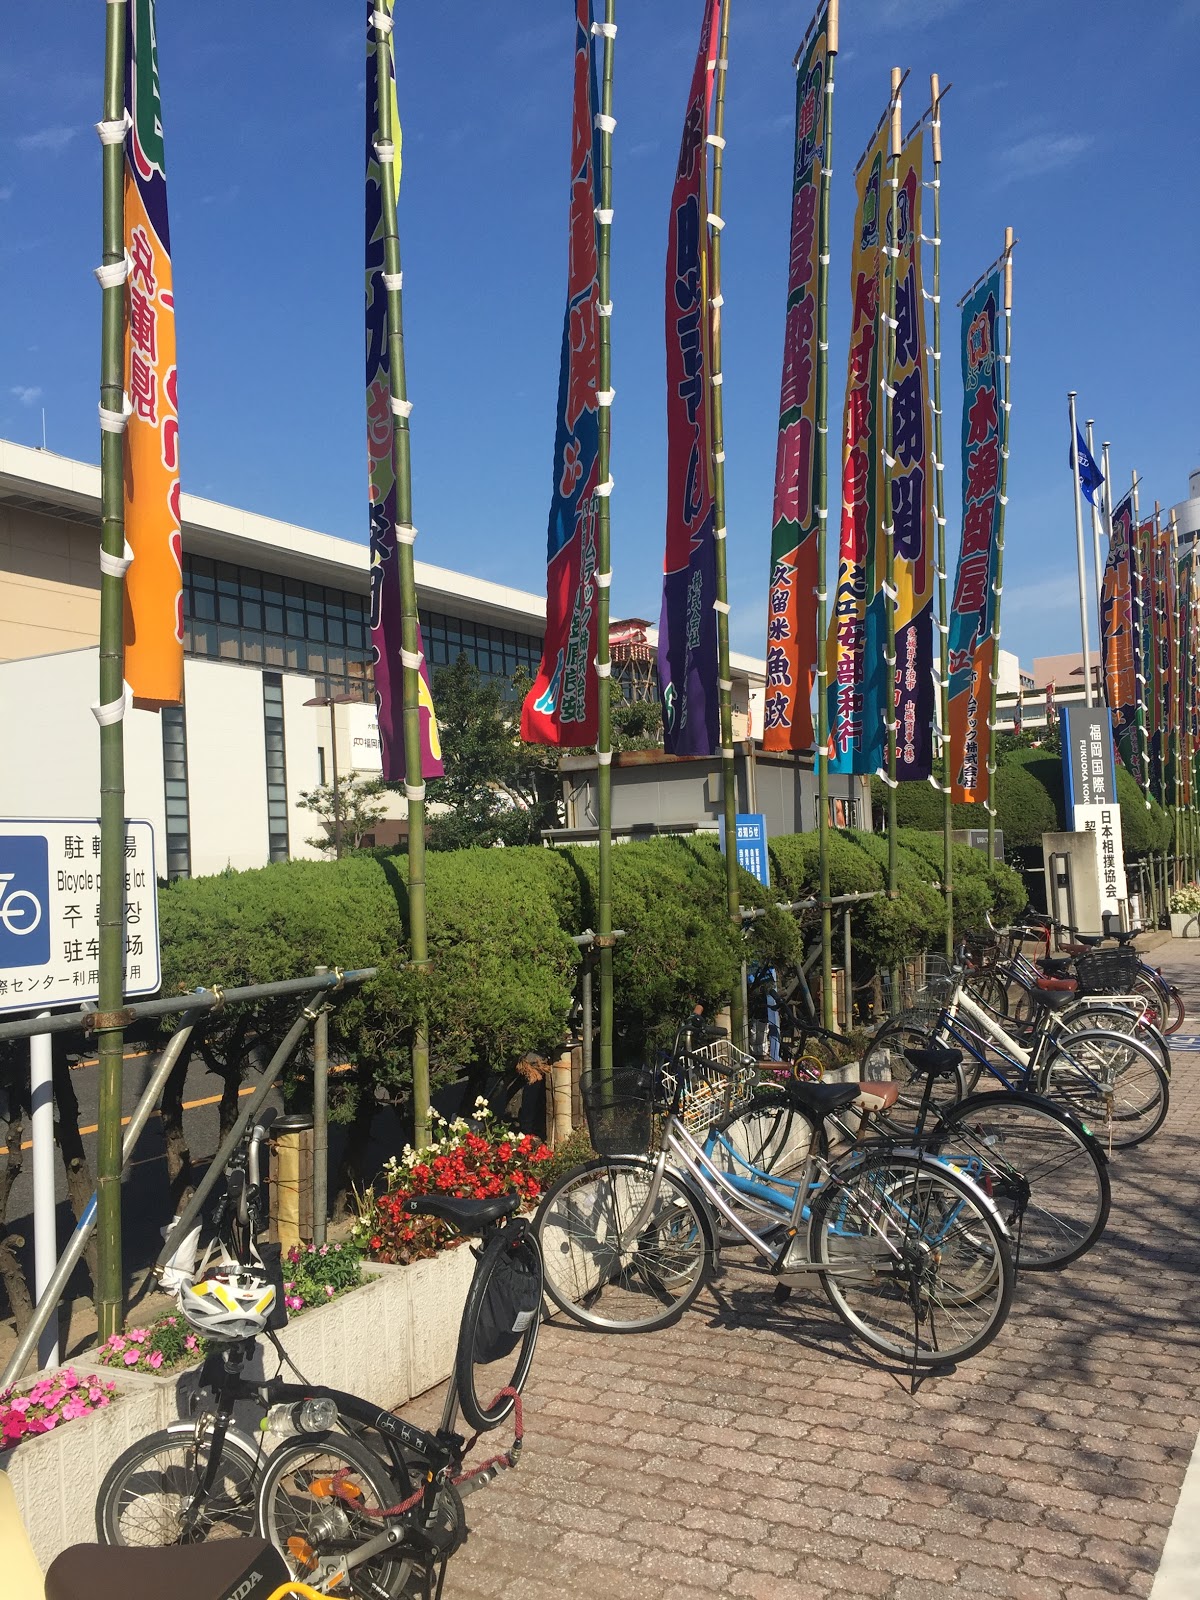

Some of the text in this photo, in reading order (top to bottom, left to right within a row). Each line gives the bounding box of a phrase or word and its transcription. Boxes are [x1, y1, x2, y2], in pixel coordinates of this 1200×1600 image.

[963, 671, 979, 788] ホームテック株式会社
[1079, 739, 1090, 782] FUKUOKA
[737, 826, 759, 838] お知らせ
[1101, 810, 1117, 898] 日本相撲協会
[57, 870, 93, 893] Bicycle
[133, 869, 146, 888] lot
[63, 901, 142, 928] 주장
